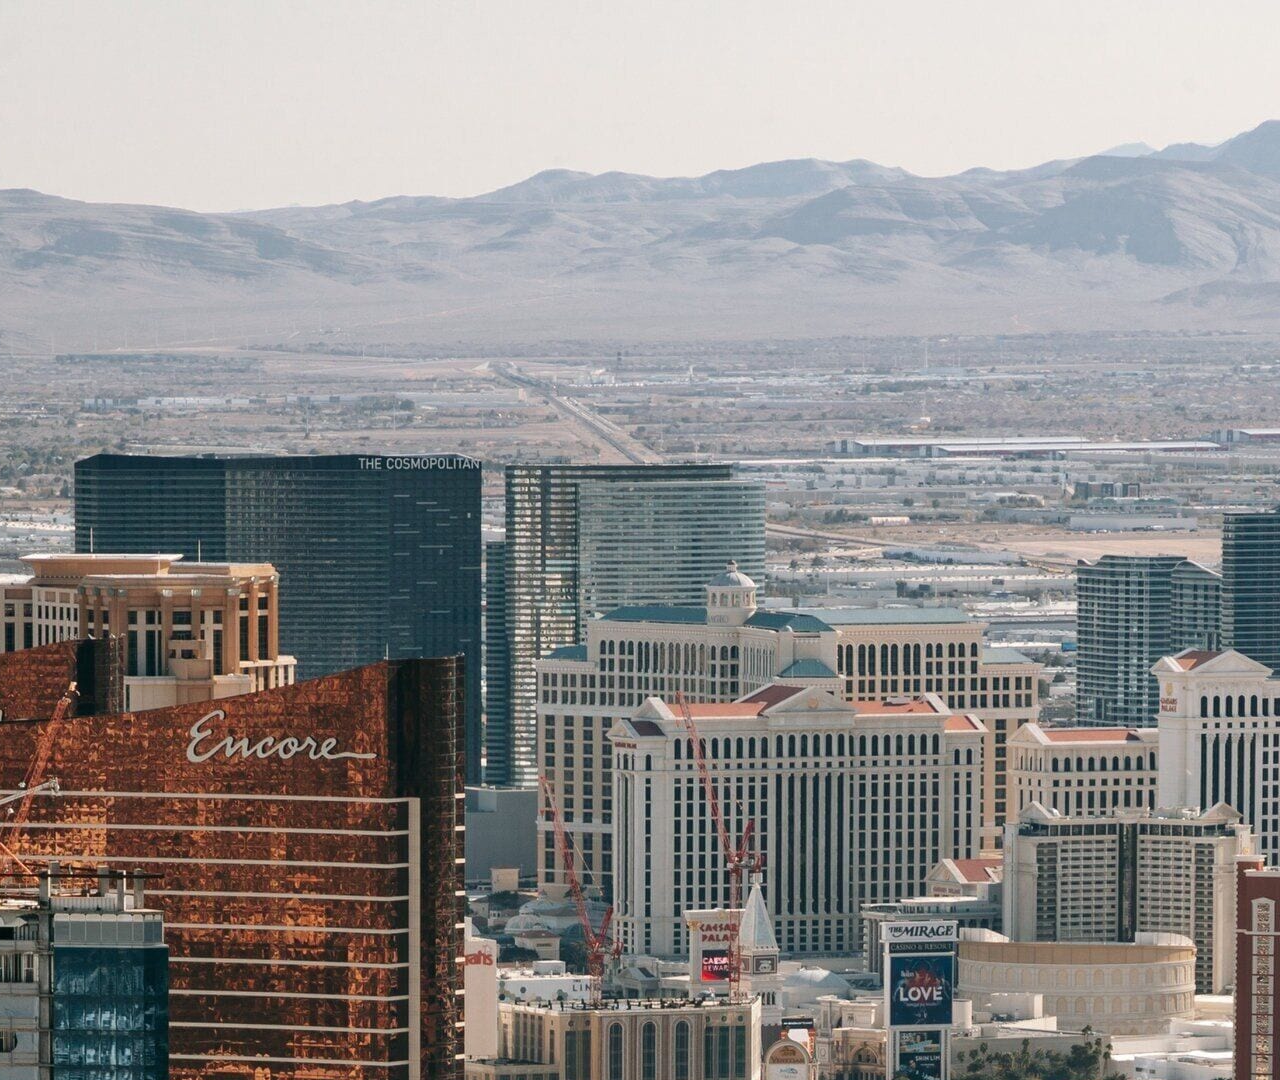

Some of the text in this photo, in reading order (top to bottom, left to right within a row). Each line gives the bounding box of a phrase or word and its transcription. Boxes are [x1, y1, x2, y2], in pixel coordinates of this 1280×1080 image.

[358, 457, 480, 470] THE COSMOPOLITAN
[186, 709, 378, 763] Encore
[894, 925, 954, 938] MIRAGE
[899, 986, 943, 1002] LOVE
